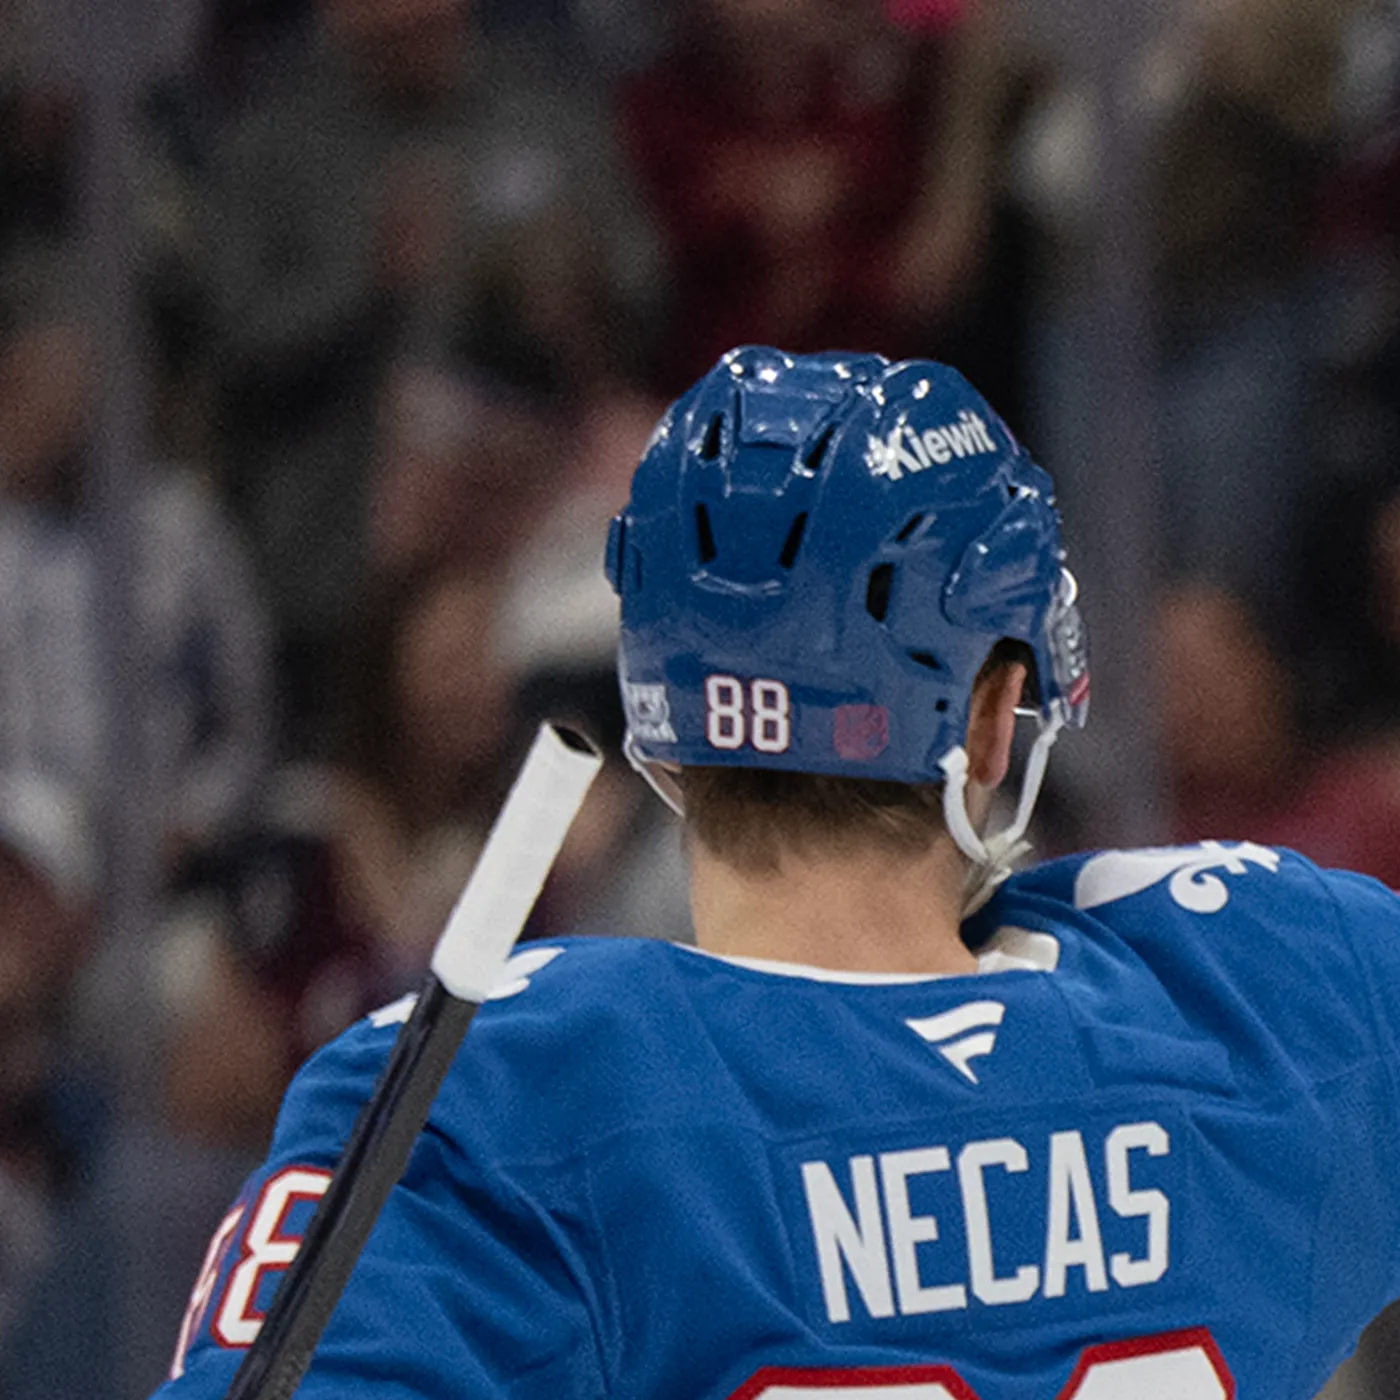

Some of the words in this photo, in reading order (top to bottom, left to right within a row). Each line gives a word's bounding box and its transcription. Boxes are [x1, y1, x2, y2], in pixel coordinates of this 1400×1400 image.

[870, 408, 996, 479] Kiewit
[704, 674, 791, 755] 88
[801, 1121, 1170, 1324] NECAS
